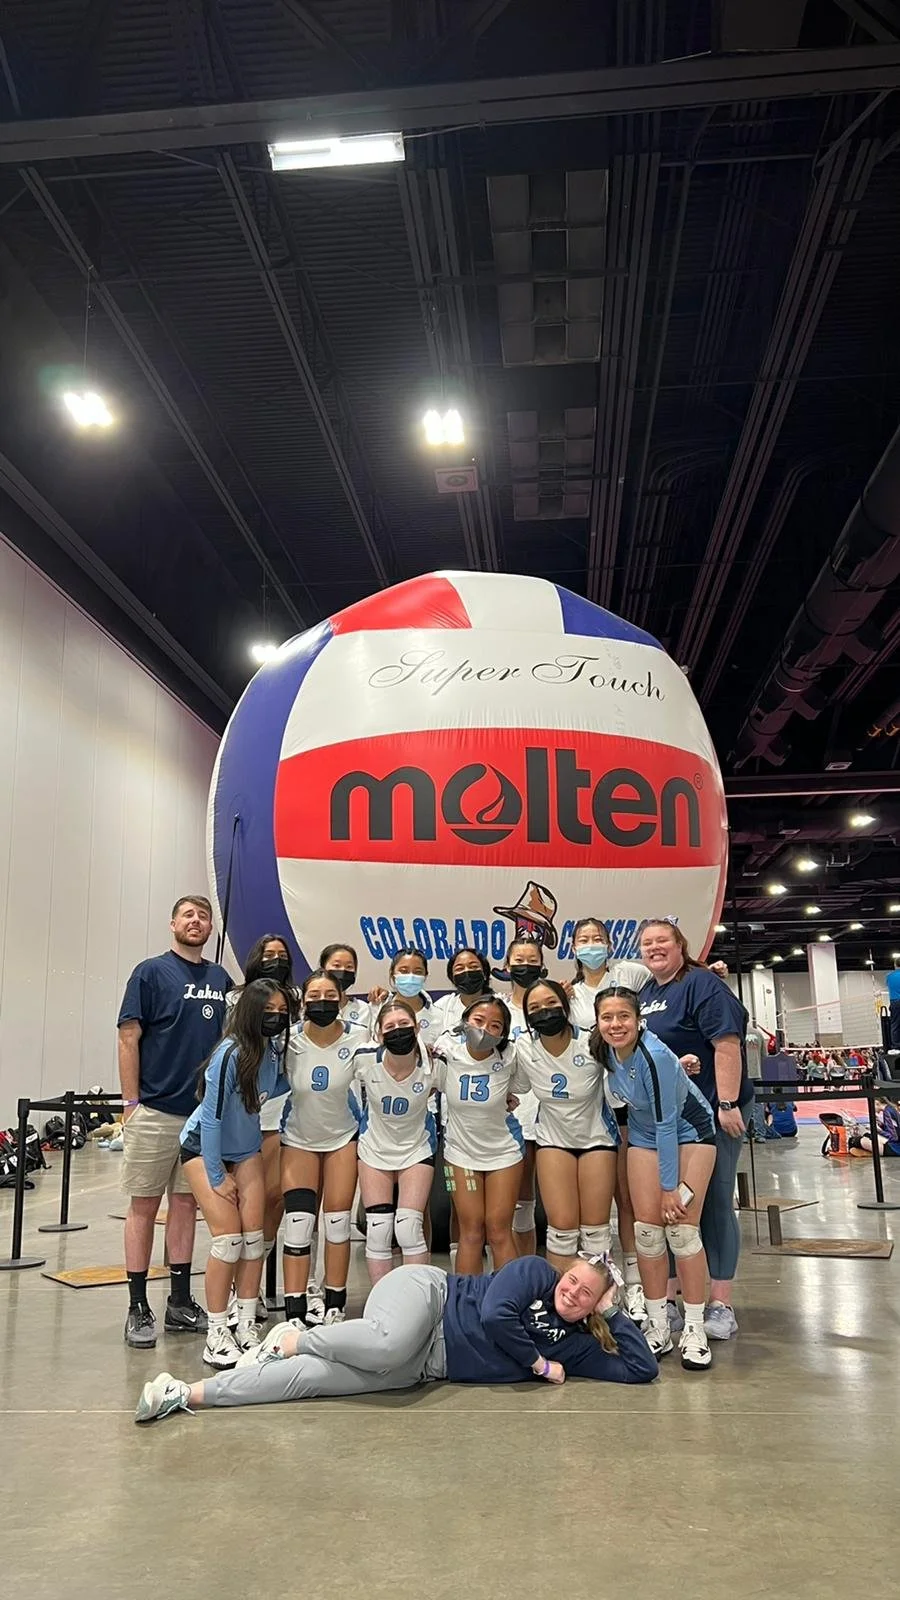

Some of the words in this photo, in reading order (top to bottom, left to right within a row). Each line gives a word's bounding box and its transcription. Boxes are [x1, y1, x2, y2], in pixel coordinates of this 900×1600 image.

[368, 650, 520, 696] Super
[531, 654, 666, 702] Touch
[330, 746, 701, 848] molten
[359, 915, 507, 961] COLORADO
[310, 1065, 330, 1092] 9
[459, 1073, 490, 1102] 13
[550, 1073, 569, 1099] 2
[381, 1095, 410, 1116] 10
